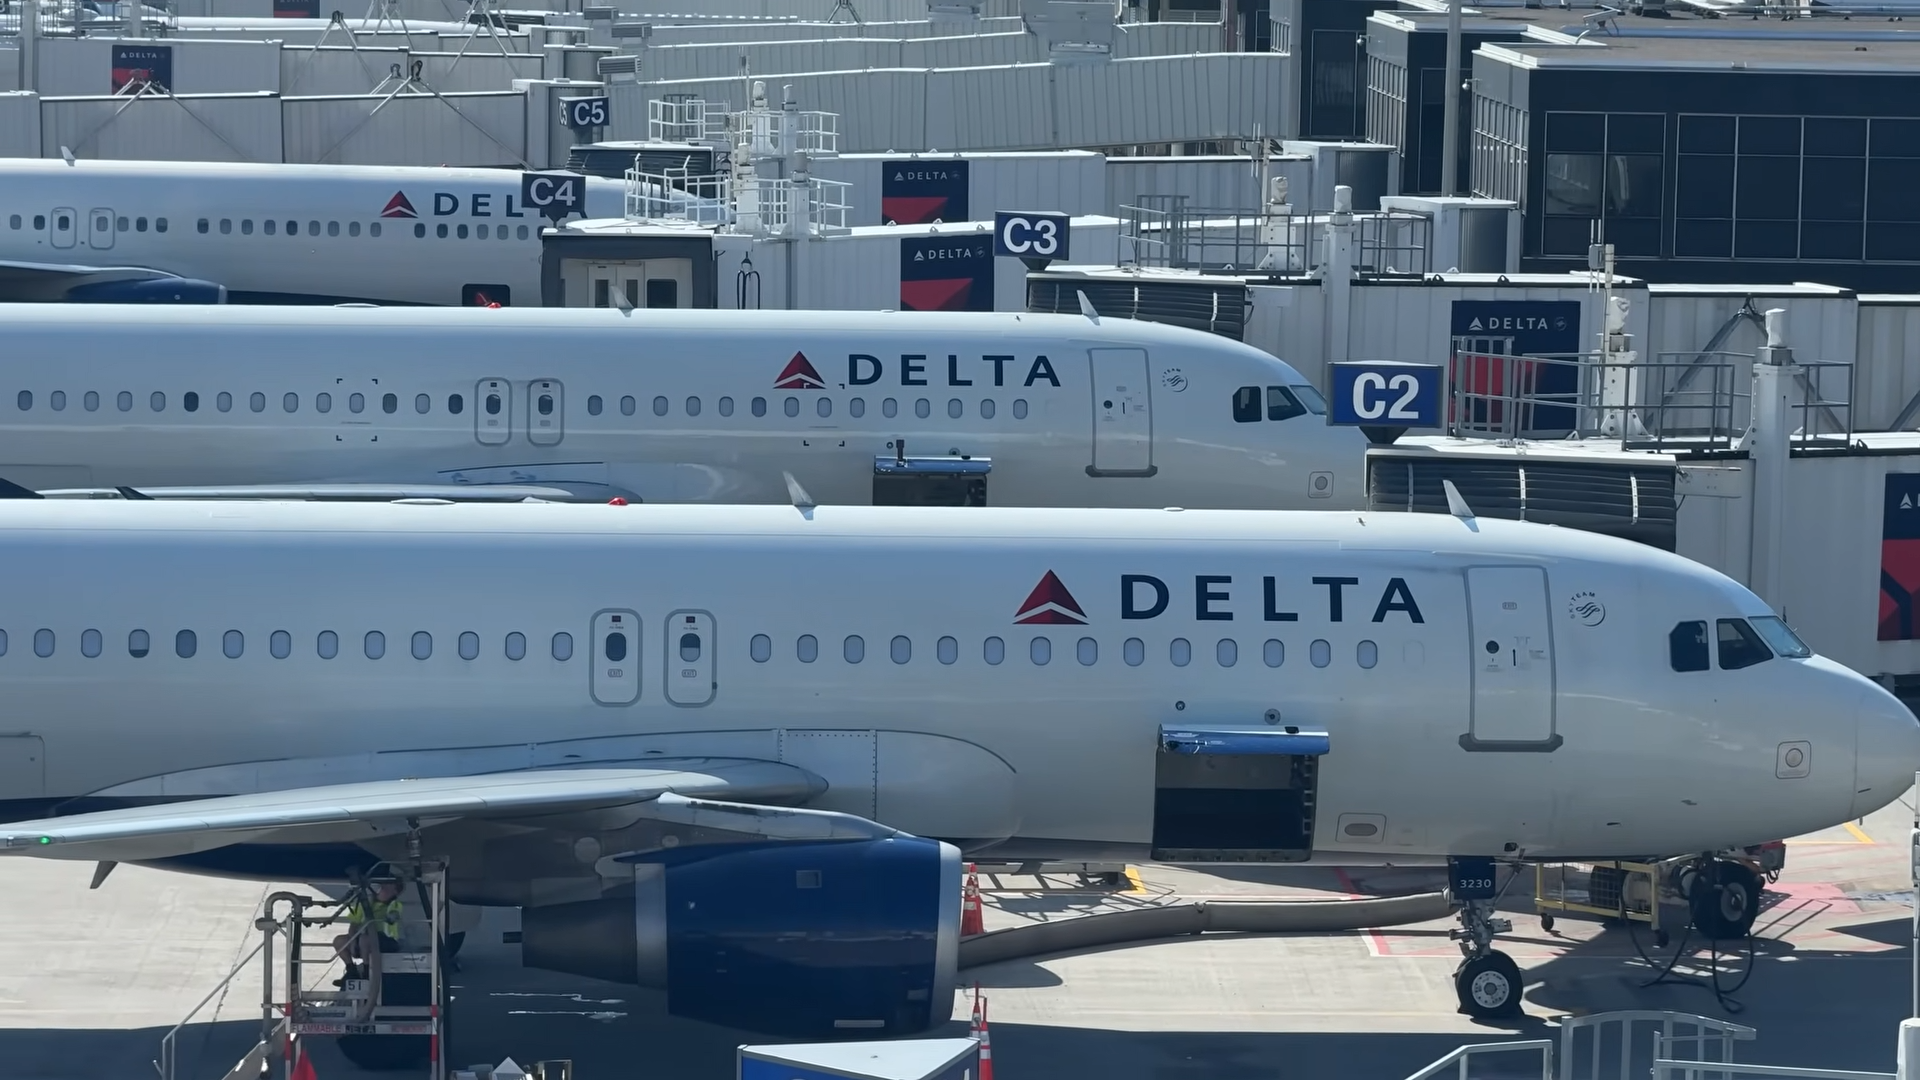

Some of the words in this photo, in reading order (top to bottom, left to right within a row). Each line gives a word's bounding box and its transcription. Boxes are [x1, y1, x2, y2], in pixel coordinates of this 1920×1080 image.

[574, 101, 605, 126] C5
[907, 171, 948, 180] DELTA
[530, 178, 576, 206] C4
[434, 193, 588, 219] DEL
[1003, 217, 1057, 255] C3
[928, 248, 972, 260] DELTA
[1489, 317, 1548, 330] DELTA
[849, 354, 1061, 387] DELTA
[1352, 372, 1420, 419] C2
[1121, 574, 1425, 624] DELTA
[1460, 879, 1492, 888] 3230
[291, 1023, 342, 1034] FLAMMABLE
